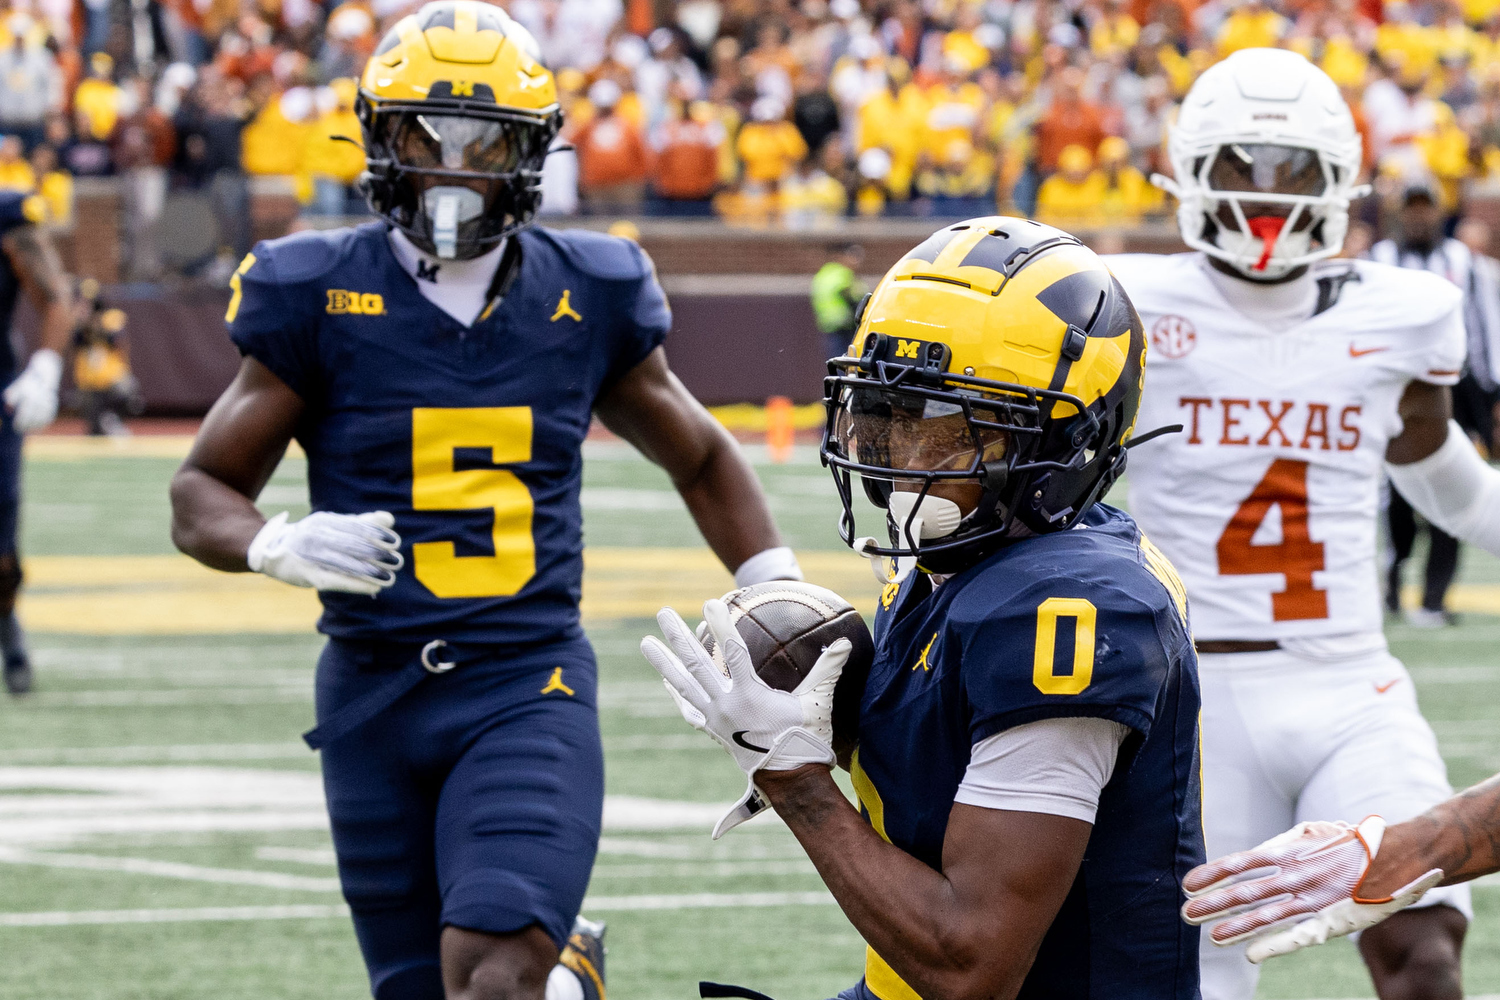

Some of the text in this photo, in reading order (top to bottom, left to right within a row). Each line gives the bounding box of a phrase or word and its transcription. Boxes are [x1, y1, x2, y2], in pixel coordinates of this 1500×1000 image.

[417, 258, 440, 283] M
[895, 339, 921, 359] M
[1179, 397, 1362, 452] TEXAS
[412, 406, 536, 599] 5
[1216, 457, 1329, 621] 4
[1033, 598, 1097, 695] 0
